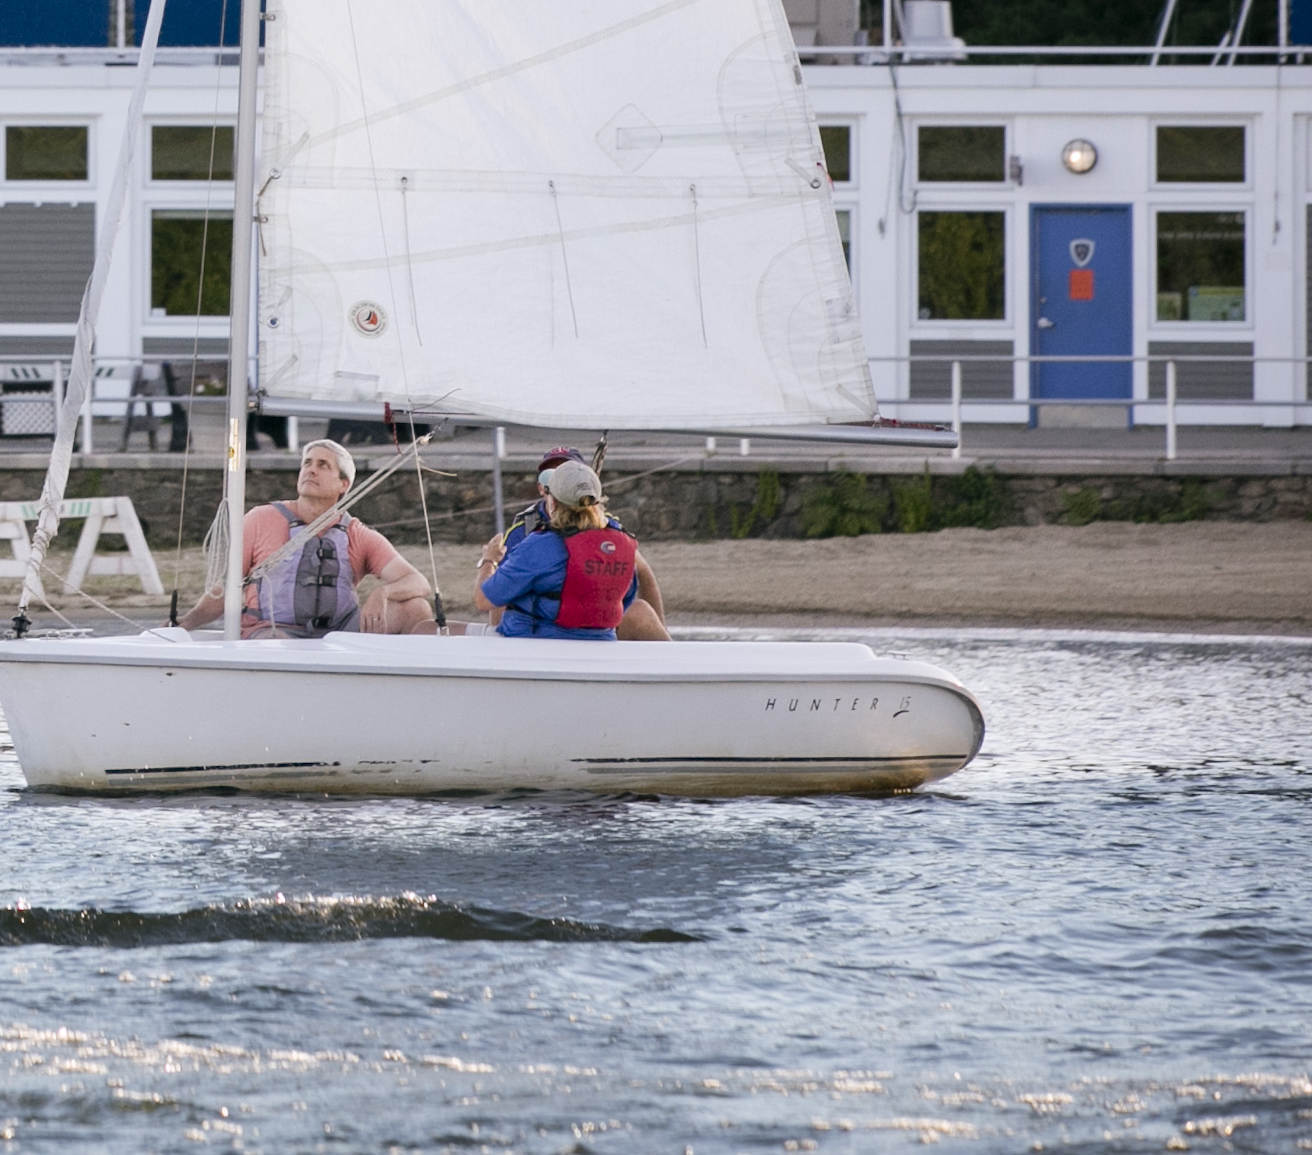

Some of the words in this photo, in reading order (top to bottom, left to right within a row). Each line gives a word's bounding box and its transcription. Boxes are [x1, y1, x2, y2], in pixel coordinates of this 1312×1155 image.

[584, 558, 629, 576] STAFF
[765, 697, 879, 712] HUNTER
[899, 696, 912, 710] 15
